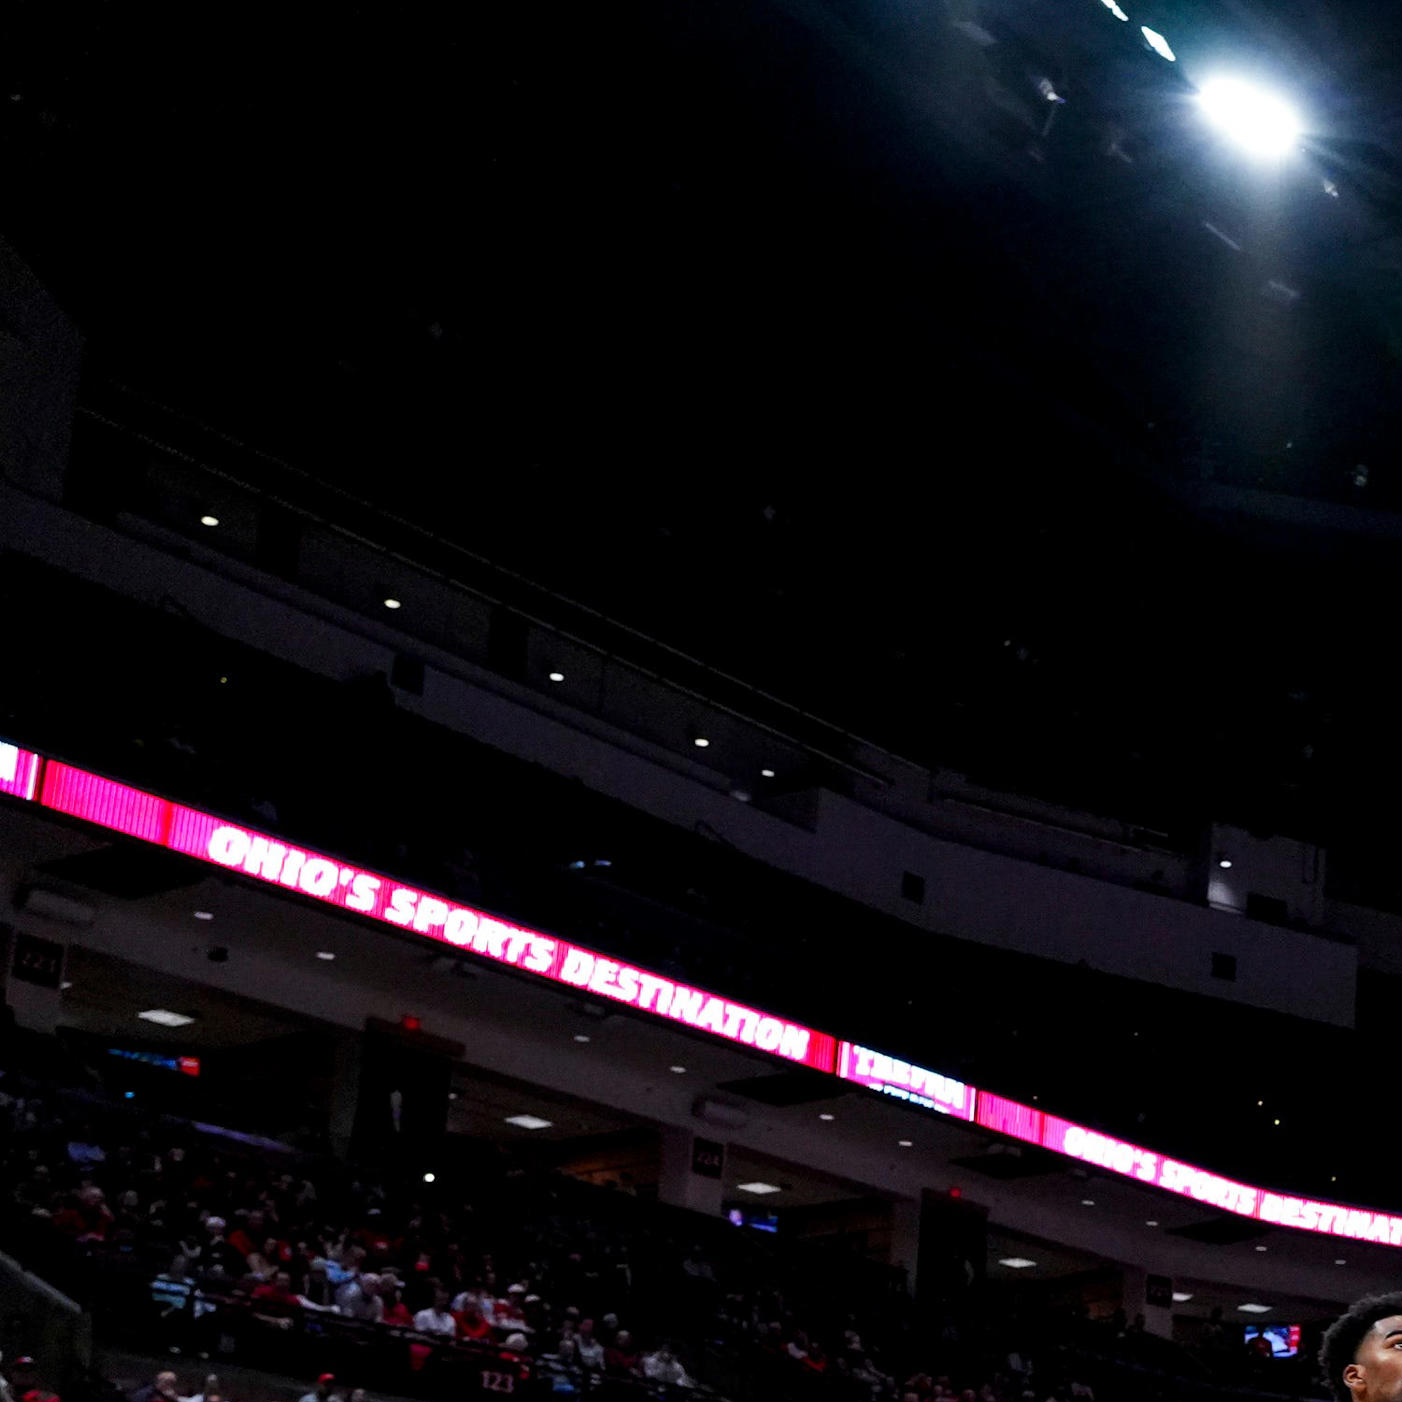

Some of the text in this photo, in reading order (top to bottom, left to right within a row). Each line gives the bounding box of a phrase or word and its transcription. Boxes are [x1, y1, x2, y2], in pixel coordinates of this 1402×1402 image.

[207, 825, 810, 1061] OHIO'S SPORTS DESTINATION
[481, 1369, 517, 1394] 123
